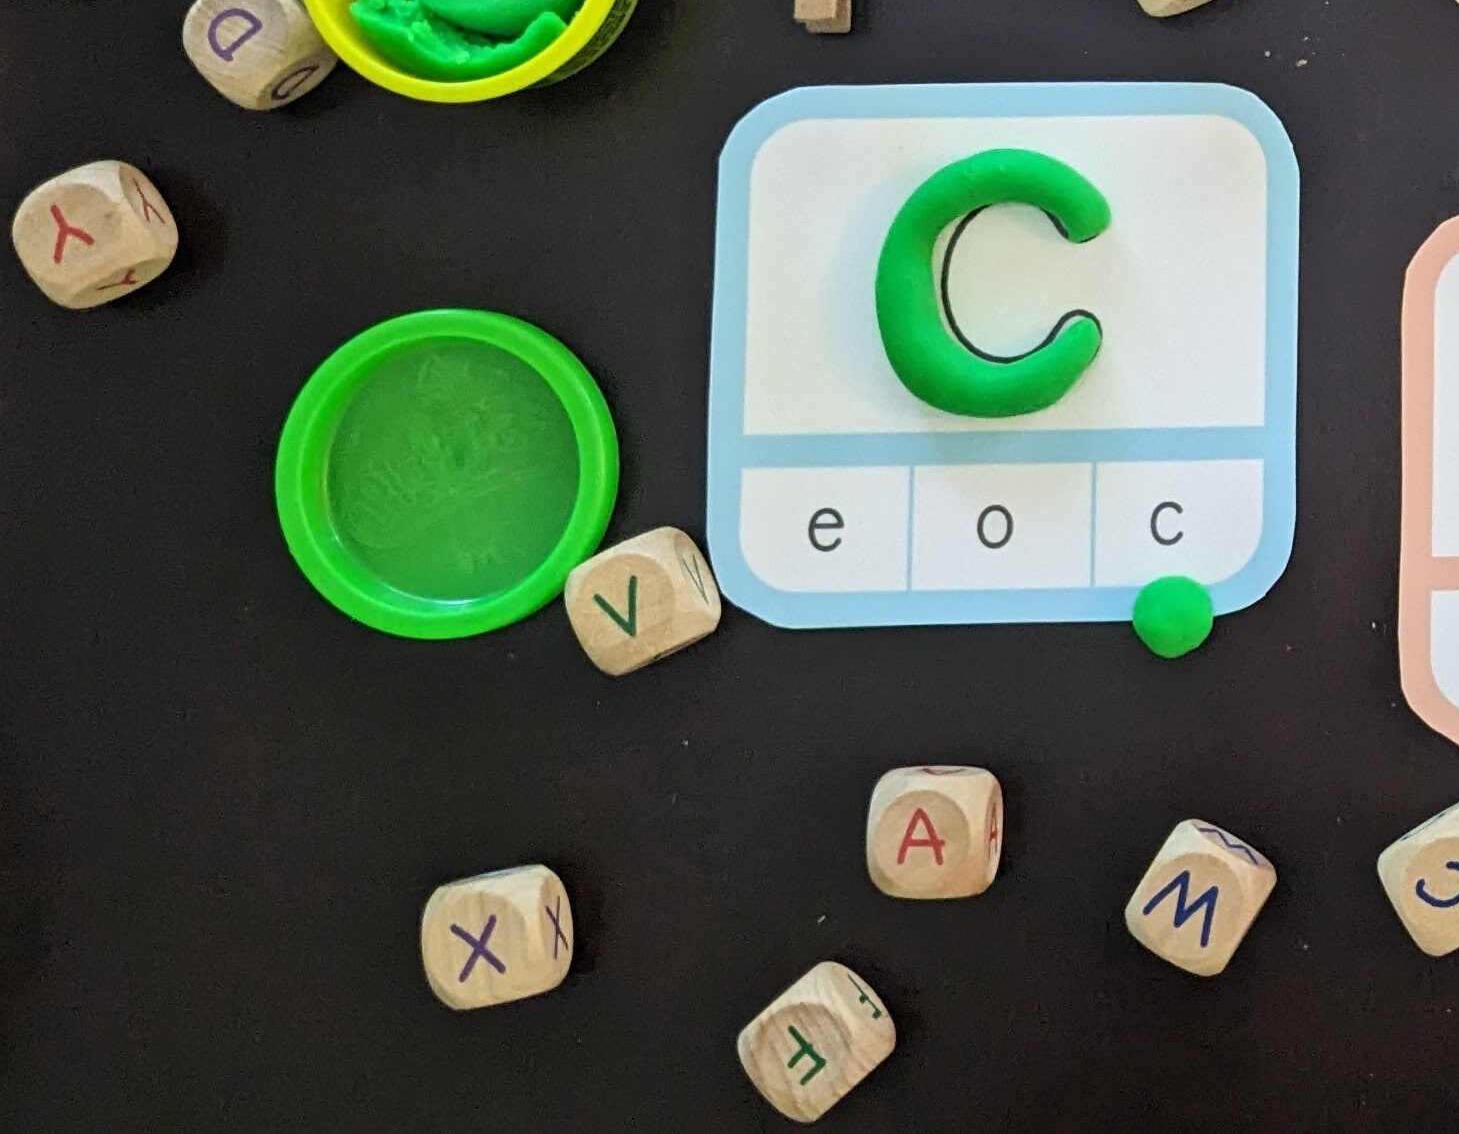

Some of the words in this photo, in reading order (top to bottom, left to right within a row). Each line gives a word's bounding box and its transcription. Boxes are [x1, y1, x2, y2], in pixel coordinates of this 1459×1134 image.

[207, 8, 263, 62] D
[271, 66, 320, 100] D
[51, 205, 95, 264] Y
[875, 148, 1111, 418] C
[808, 507, 845, 552] e
[976, 504, 1014, 549] o
[1150, 501, 1184, 546] c
[593, 575, 637, 637] V
[897, 808, 945, 865] A
[450, 914, 506, 983] X
[546, 895, 569, 961] X
[787, 1025, 827, 1086] F
